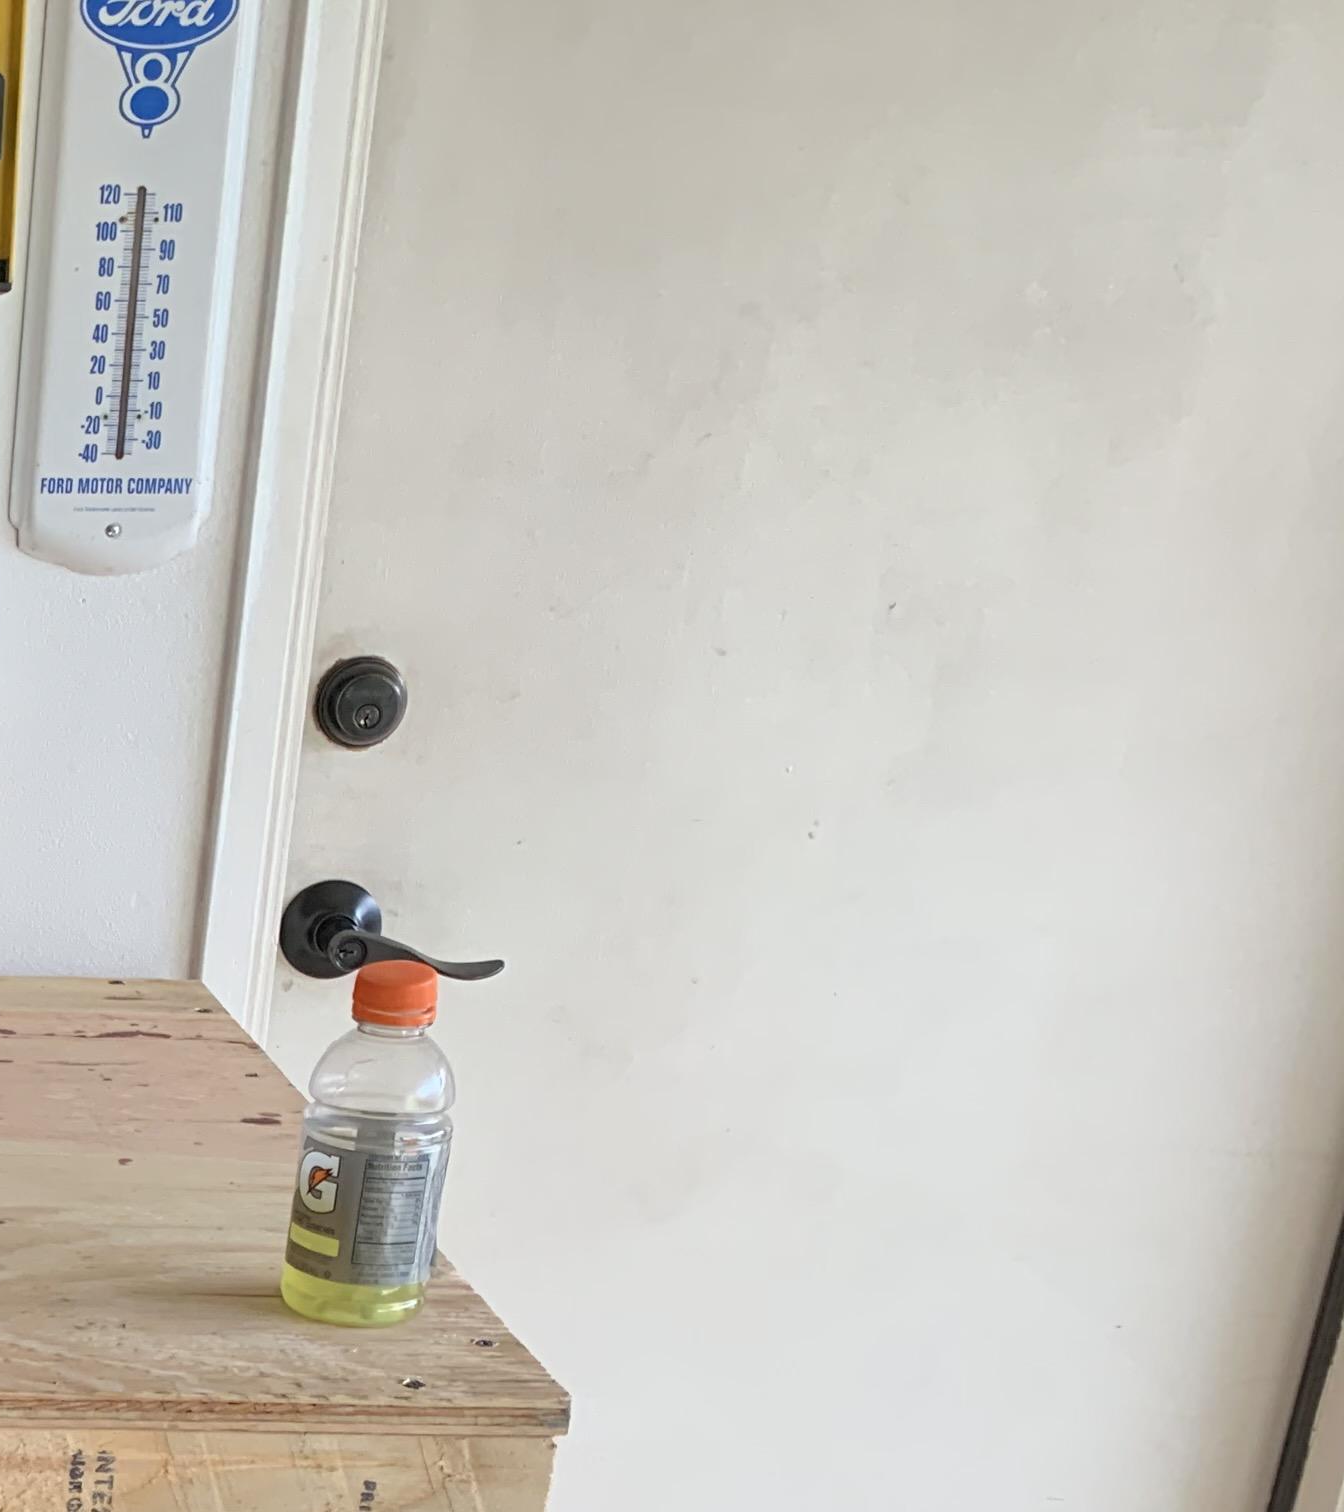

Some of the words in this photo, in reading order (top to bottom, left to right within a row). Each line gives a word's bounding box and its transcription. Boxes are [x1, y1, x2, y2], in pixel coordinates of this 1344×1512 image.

[99, 184, 121, 204] 120
[163, 203, 183, 222] 110
[95, 221, 117, 241] 100
[159, 240, 175, 260] 90
[98, 257, 114, 277] 80
[156, 274, 170, 294] 70
[95, 291, 111, 311] 60
[153, 308, 169, 328] 50
[92, 324, 108, 343] 40
[149, 340, 165, 360] 30
[90, 355, 106, 374] 20
[148, 371, 160, 390] 10
[95, 386, 103, 405] 0
[144, 401, 162, 420] -10
[80, 415, 100, 434] -20
[141, 430, 161, 450] -30
[78, 443, 98, 463] -40
[40, 477, 73, 495] FORD
[77, 477, 123, 495] MOTOR
[127, 478, 192, 495] COMPANY
[299, 1150, 342, 1215] G
